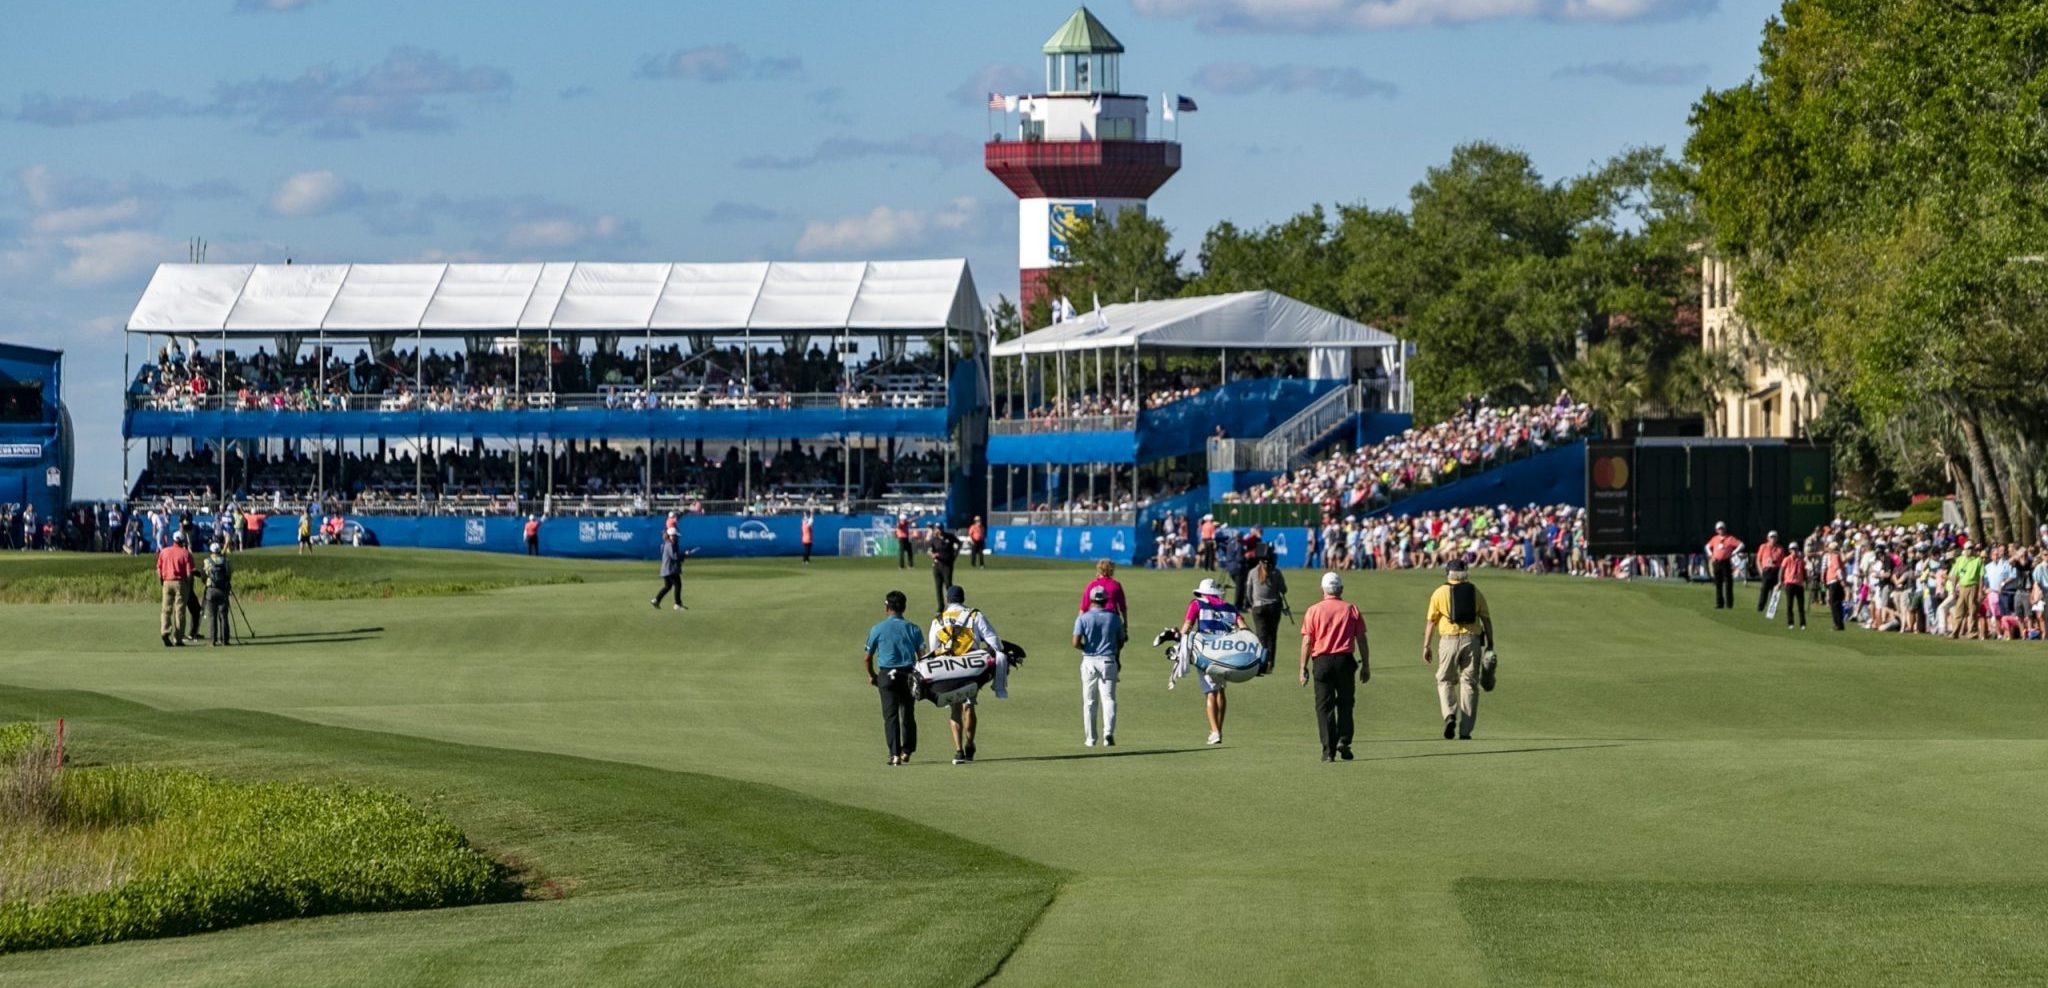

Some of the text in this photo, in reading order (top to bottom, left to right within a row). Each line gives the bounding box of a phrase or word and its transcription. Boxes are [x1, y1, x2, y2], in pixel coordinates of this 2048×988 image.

[1792, 494, 1825, 505] ROLEX
[597, 521, 619, 531] RBC
[1201, 640, 1260, 653] FUBON
[927, 656, 985, 673] PING
